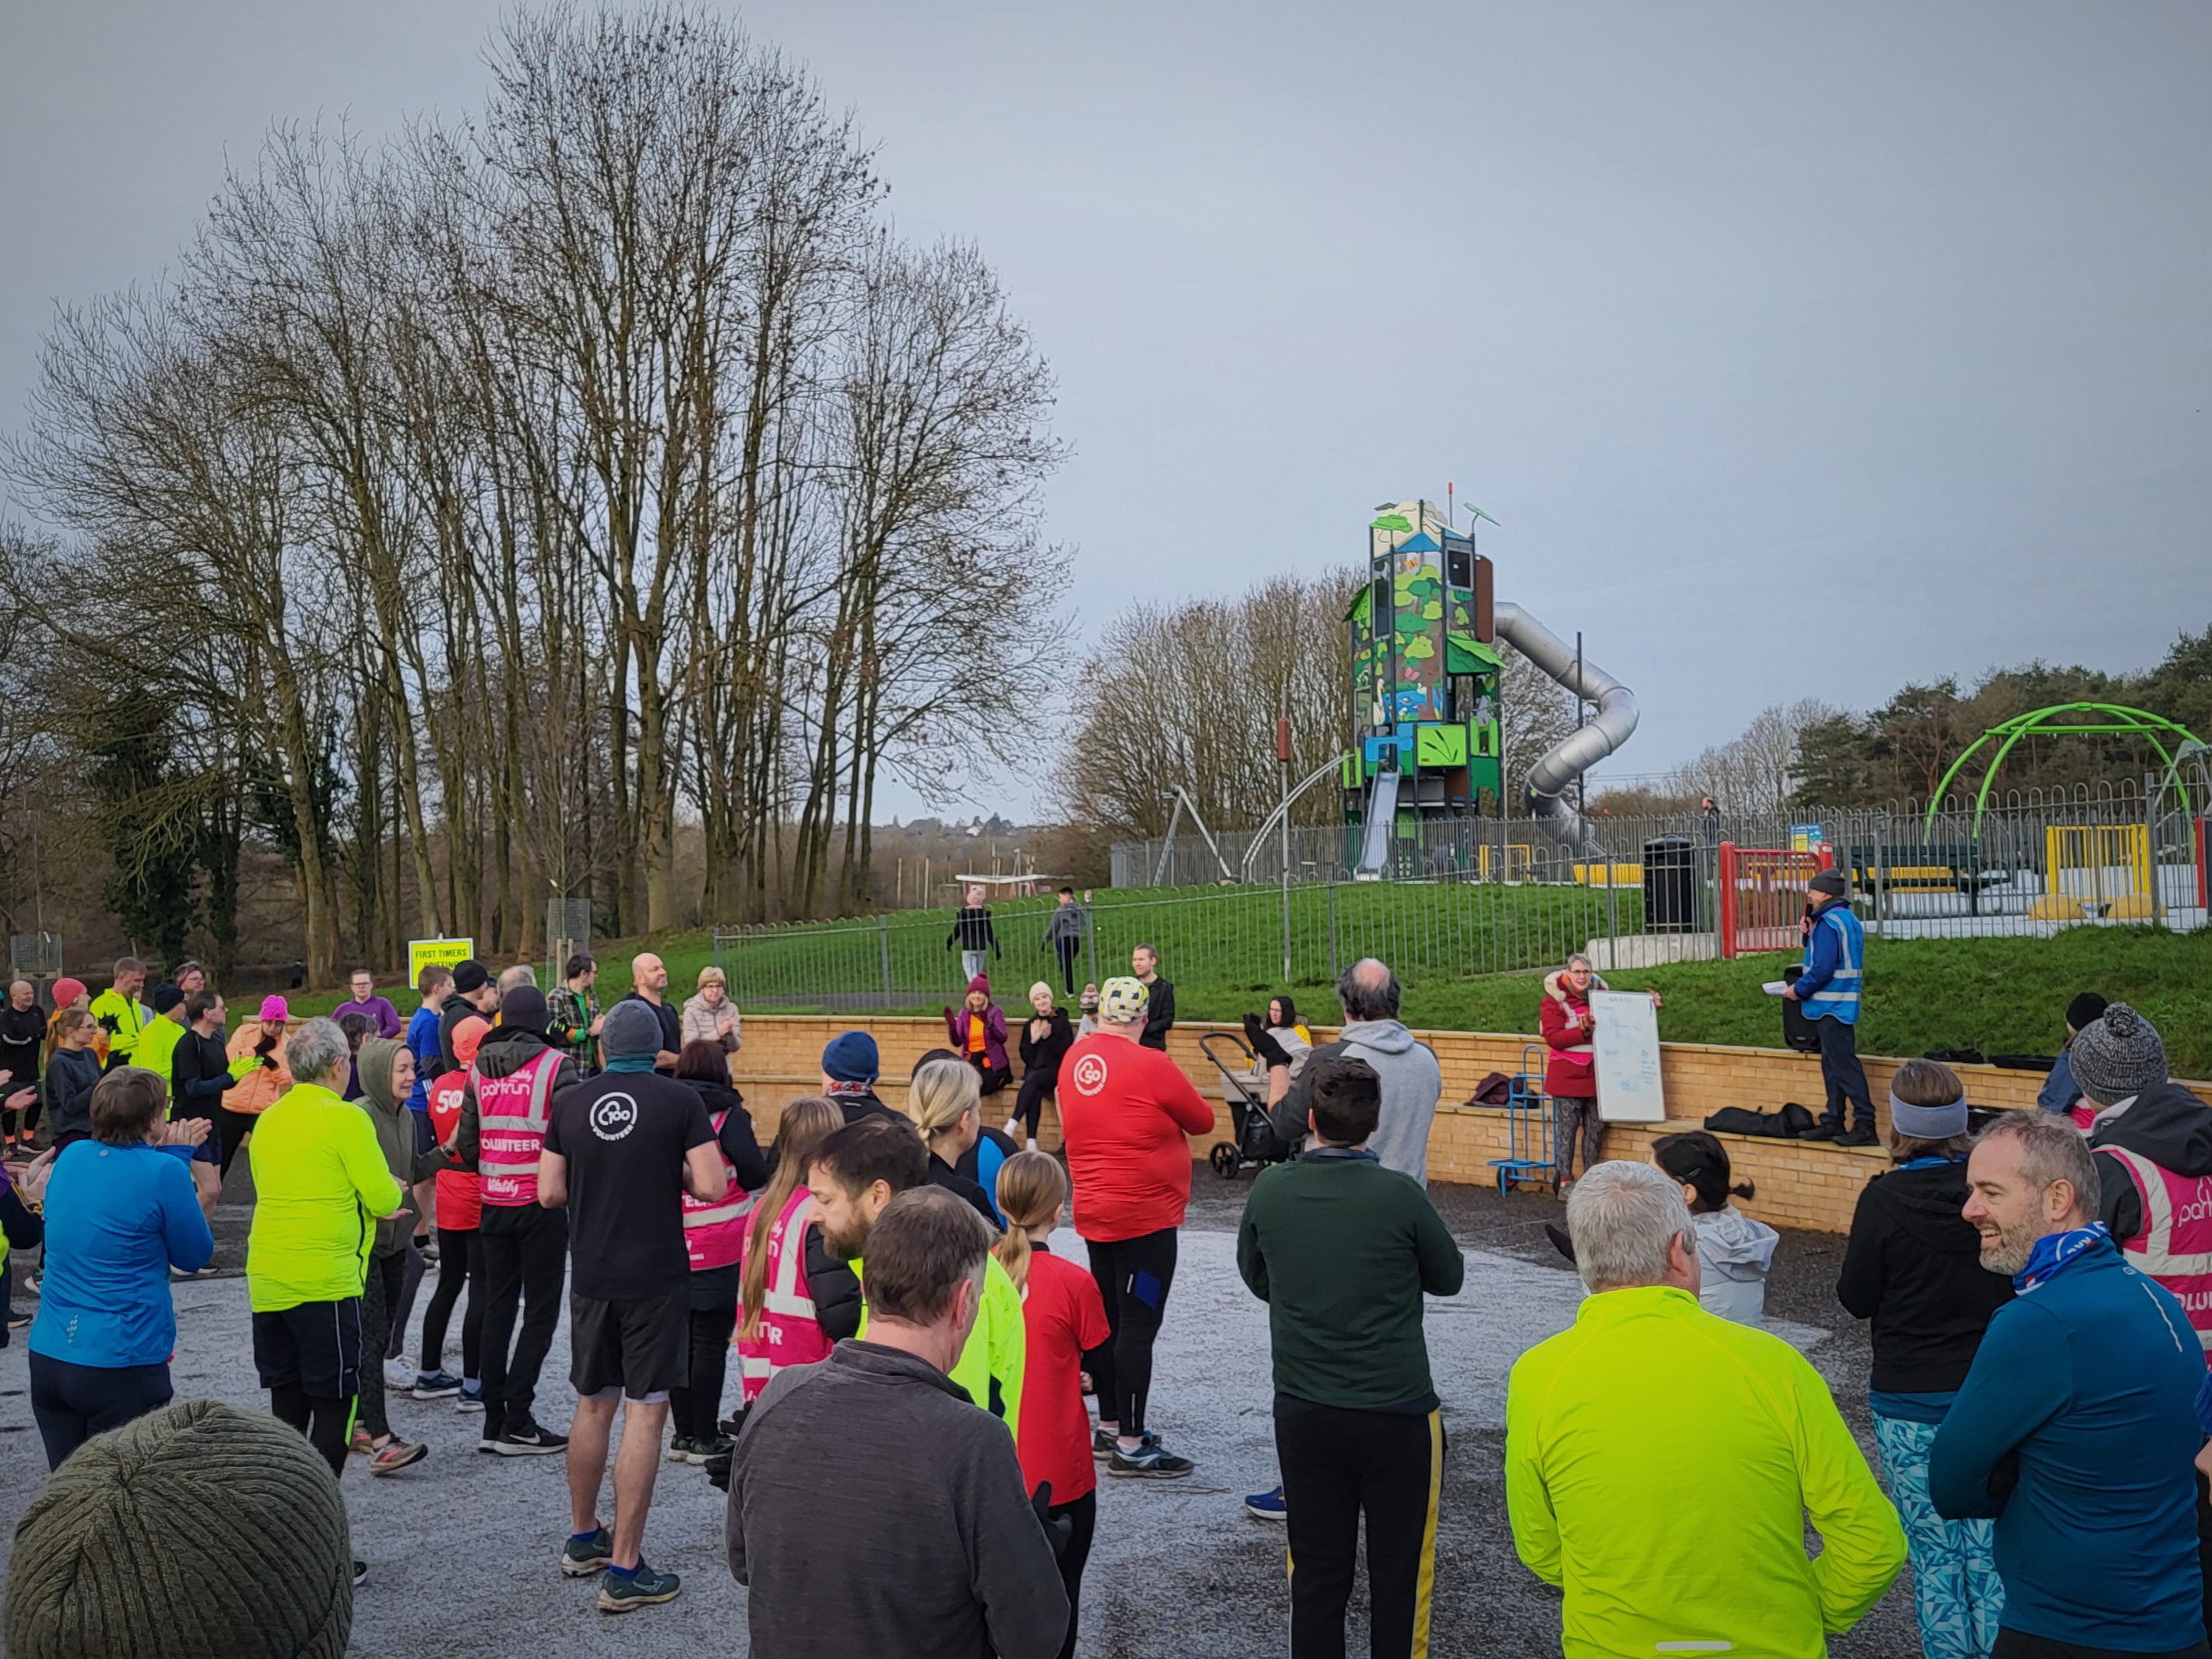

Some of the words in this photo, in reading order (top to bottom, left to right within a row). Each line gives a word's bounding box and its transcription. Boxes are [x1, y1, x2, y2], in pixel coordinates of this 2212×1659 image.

[415, 949, 437, 959] FIRST
[438, 949, 467, 958] TIMERS
[480, 1078, 531, 1101] parkrun
[435, 1089, 465, 1114] 50
[607, 1110, 631, 1125] 100
